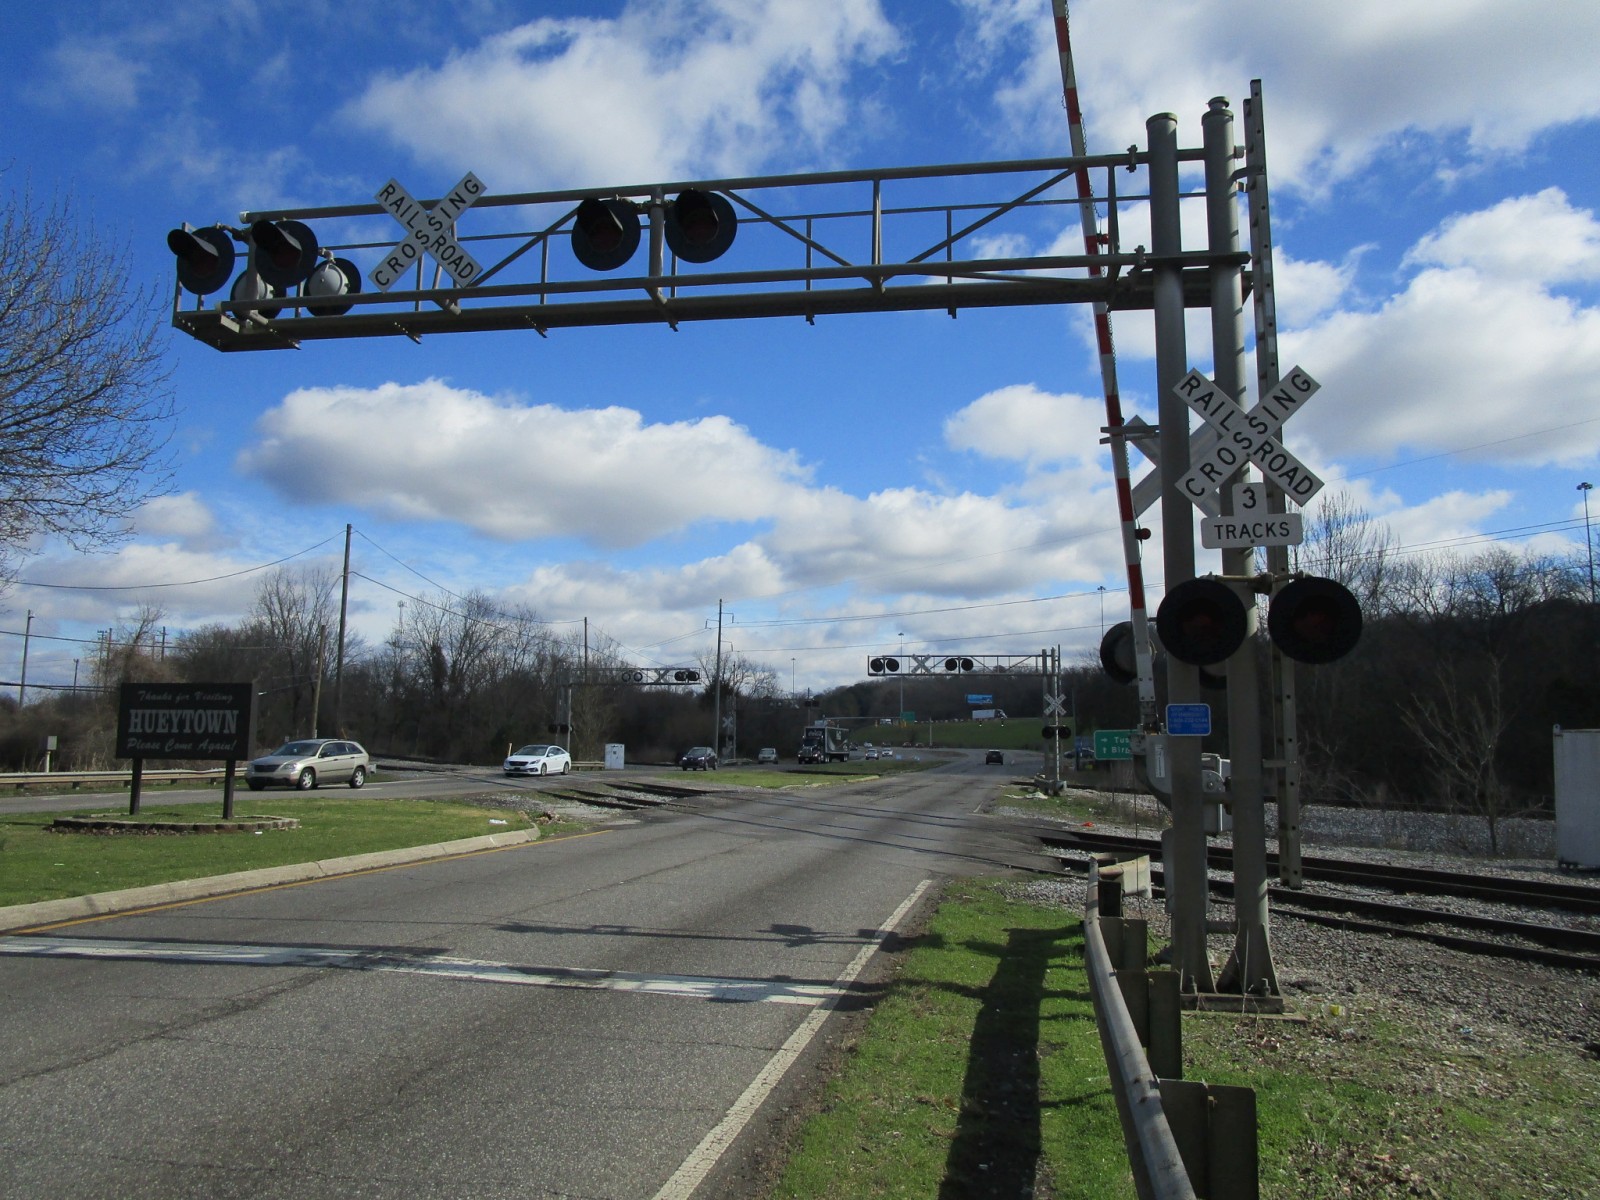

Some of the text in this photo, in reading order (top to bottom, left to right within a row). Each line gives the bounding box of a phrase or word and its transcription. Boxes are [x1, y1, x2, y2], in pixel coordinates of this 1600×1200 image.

[374, 179, 480, 287] CROSSING
[1185, 373, 1312, 498] CROSSING
[1242, 486, 1257, 509] 3
[1213, 521, 1290, 540] TRACKS
[137, 690, 172, 702] Thanks
[128, 709, 239, 734] HUEYTOWN
[127, 737, 238, 754] Please Come Again!
